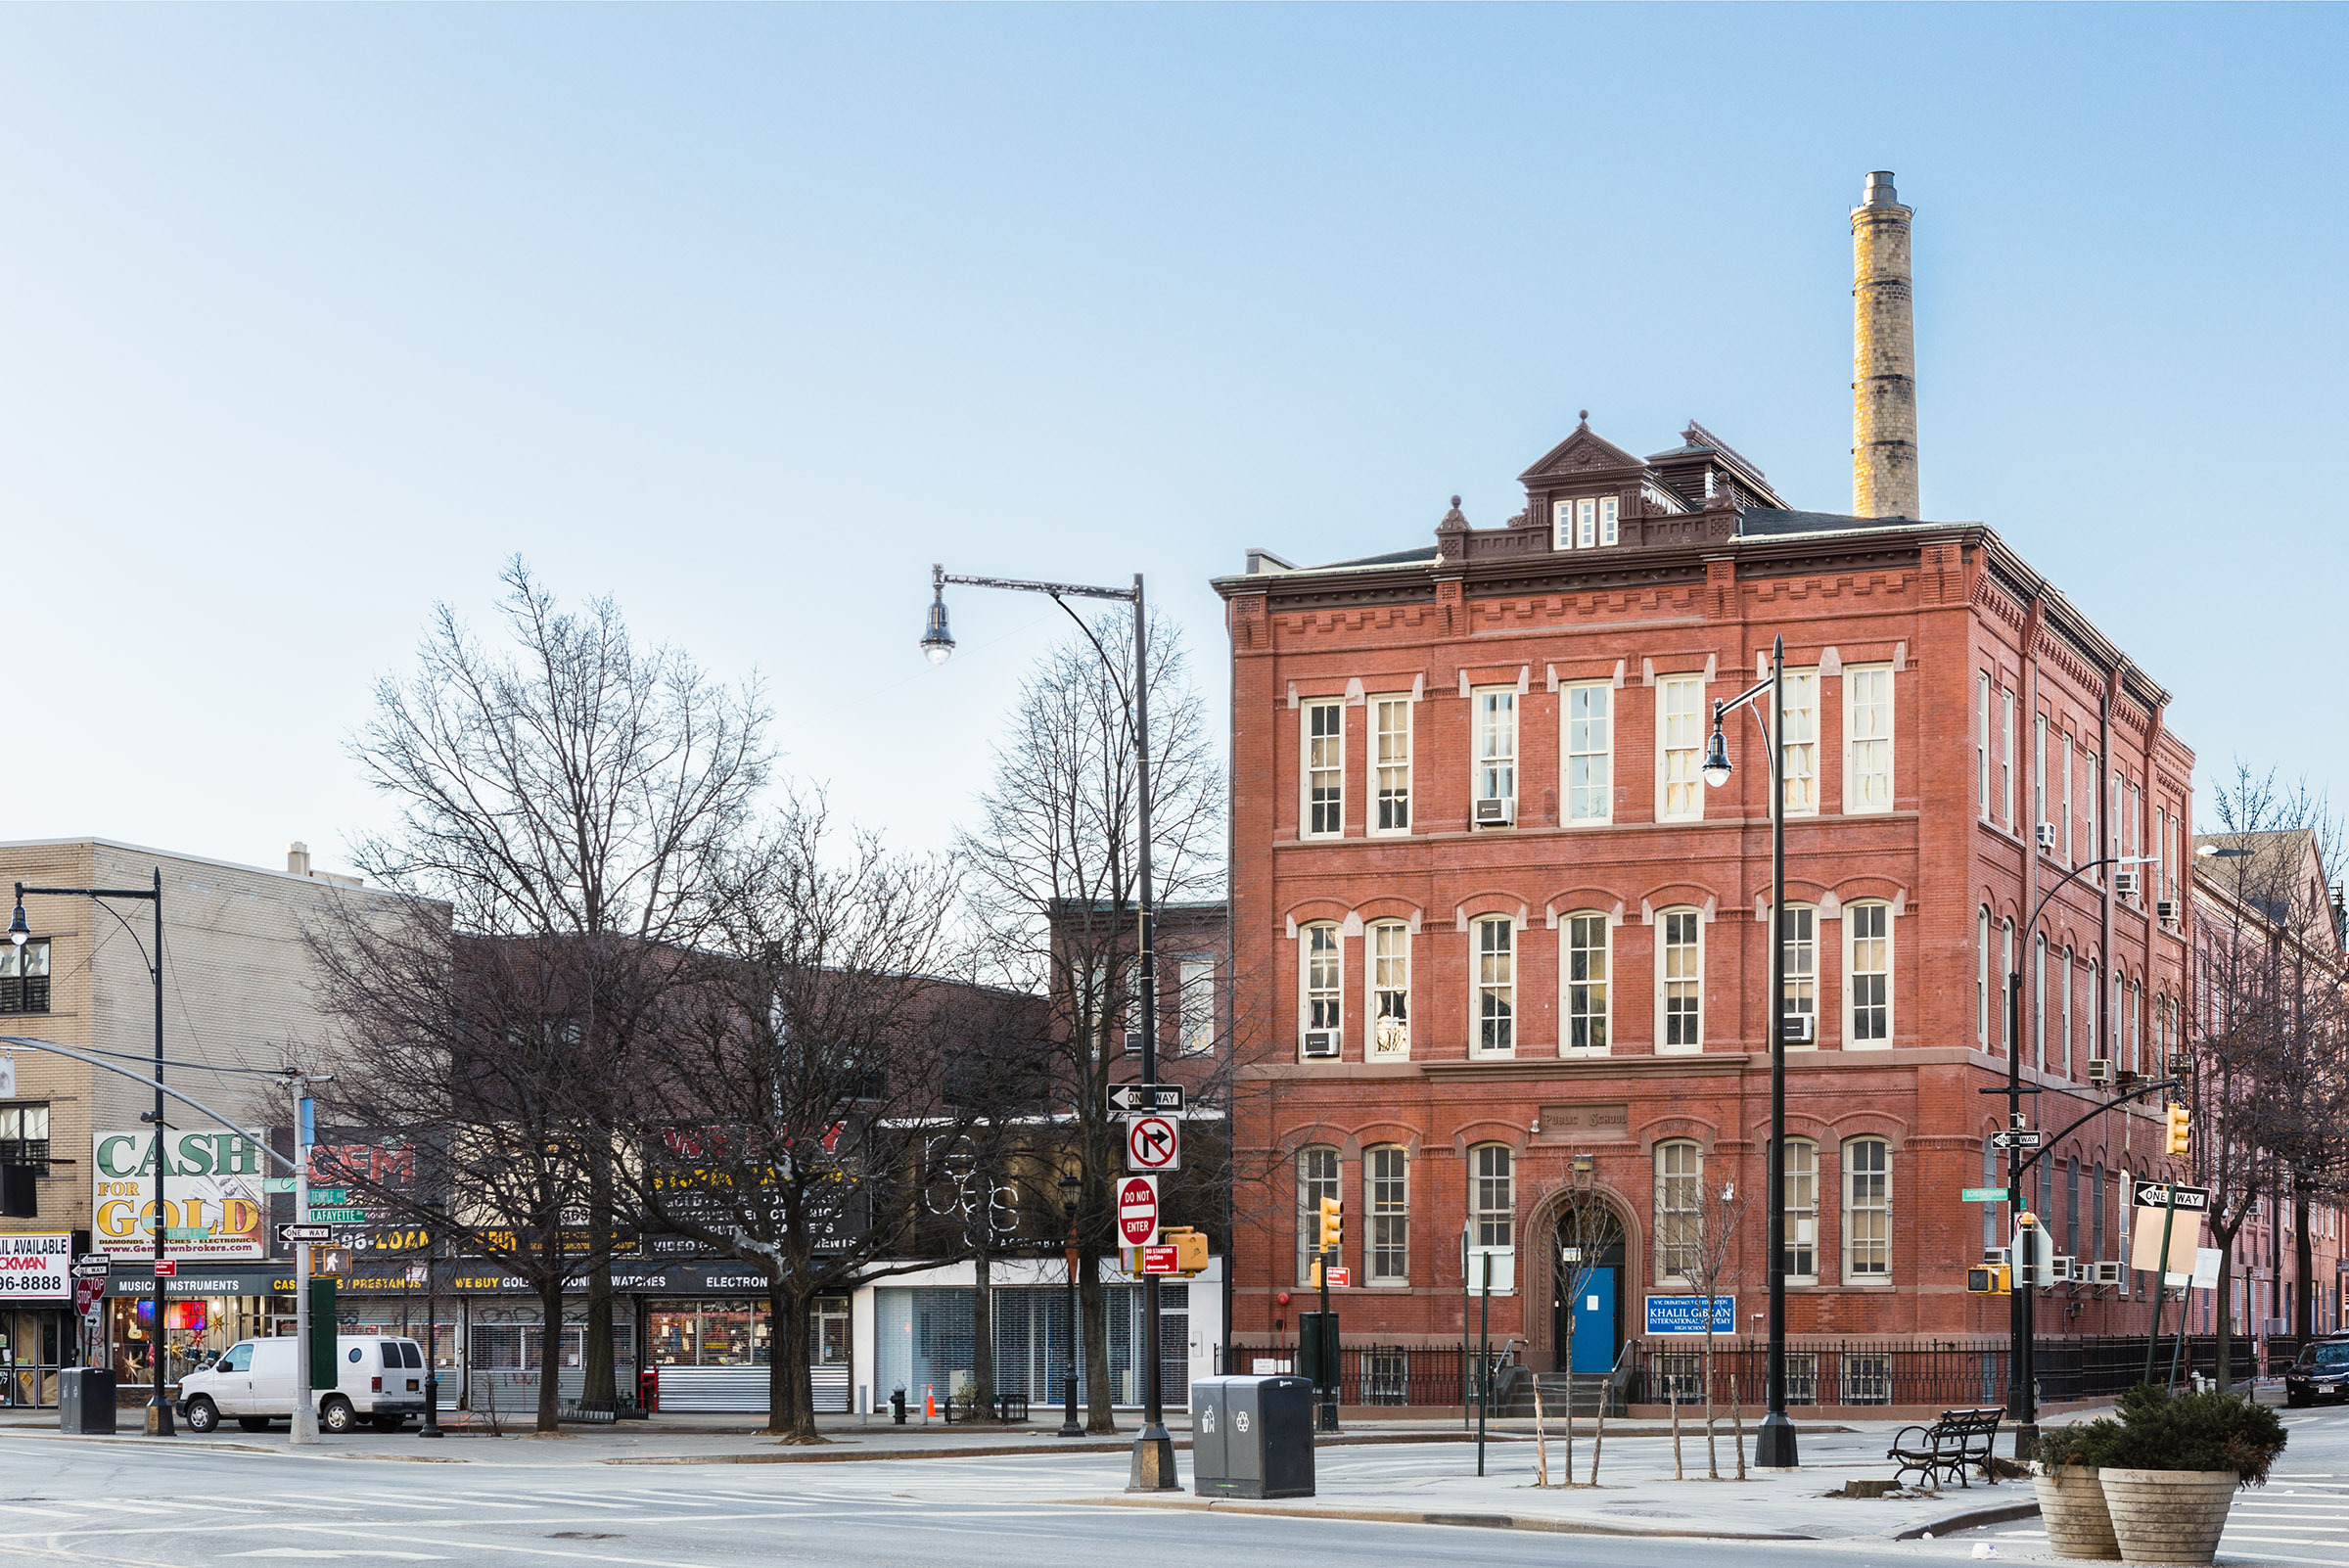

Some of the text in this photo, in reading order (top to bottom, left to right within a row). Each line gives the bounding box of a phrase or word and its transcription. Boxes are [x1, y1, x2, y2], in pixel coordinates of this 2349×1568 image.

[1128, 1092, 1142, 1104] ON
[97, 1134, 260, 1177] CASH
[98, 1181, 140, 1196] FOR
[311, 1191, 334, 1203] TEMPLE
[1125, 1190, 1150, 1203] DO NOT
[2145, 1190, 2199, 1205] ONE WAY
[98, 1200, 259, 1237] GOLD
[312, 1210, 355, 1222] LAFAYETTE
[167, 1228, 199, 1238] TEMPLE
[1127, 1221, 1148, 1233] ENTER
[14, 1238, 67, 1255] AVAILABLE
[103, 1244, 253, 1253] www.Gemawnbrokers.com
[166, 1280, 240, 1291] INSTRUMENTS
[455, 1277, 472, 1289] WE
[475, 1277, 499, 1289] BUY
[611, 1275, 667, 1288] WATCHES
[705, 1275, 769, 1288] ELECTRON
[77, 1290, 92, 1304] STOP
[1649, 1309, 1689, 1317] KHALIL
